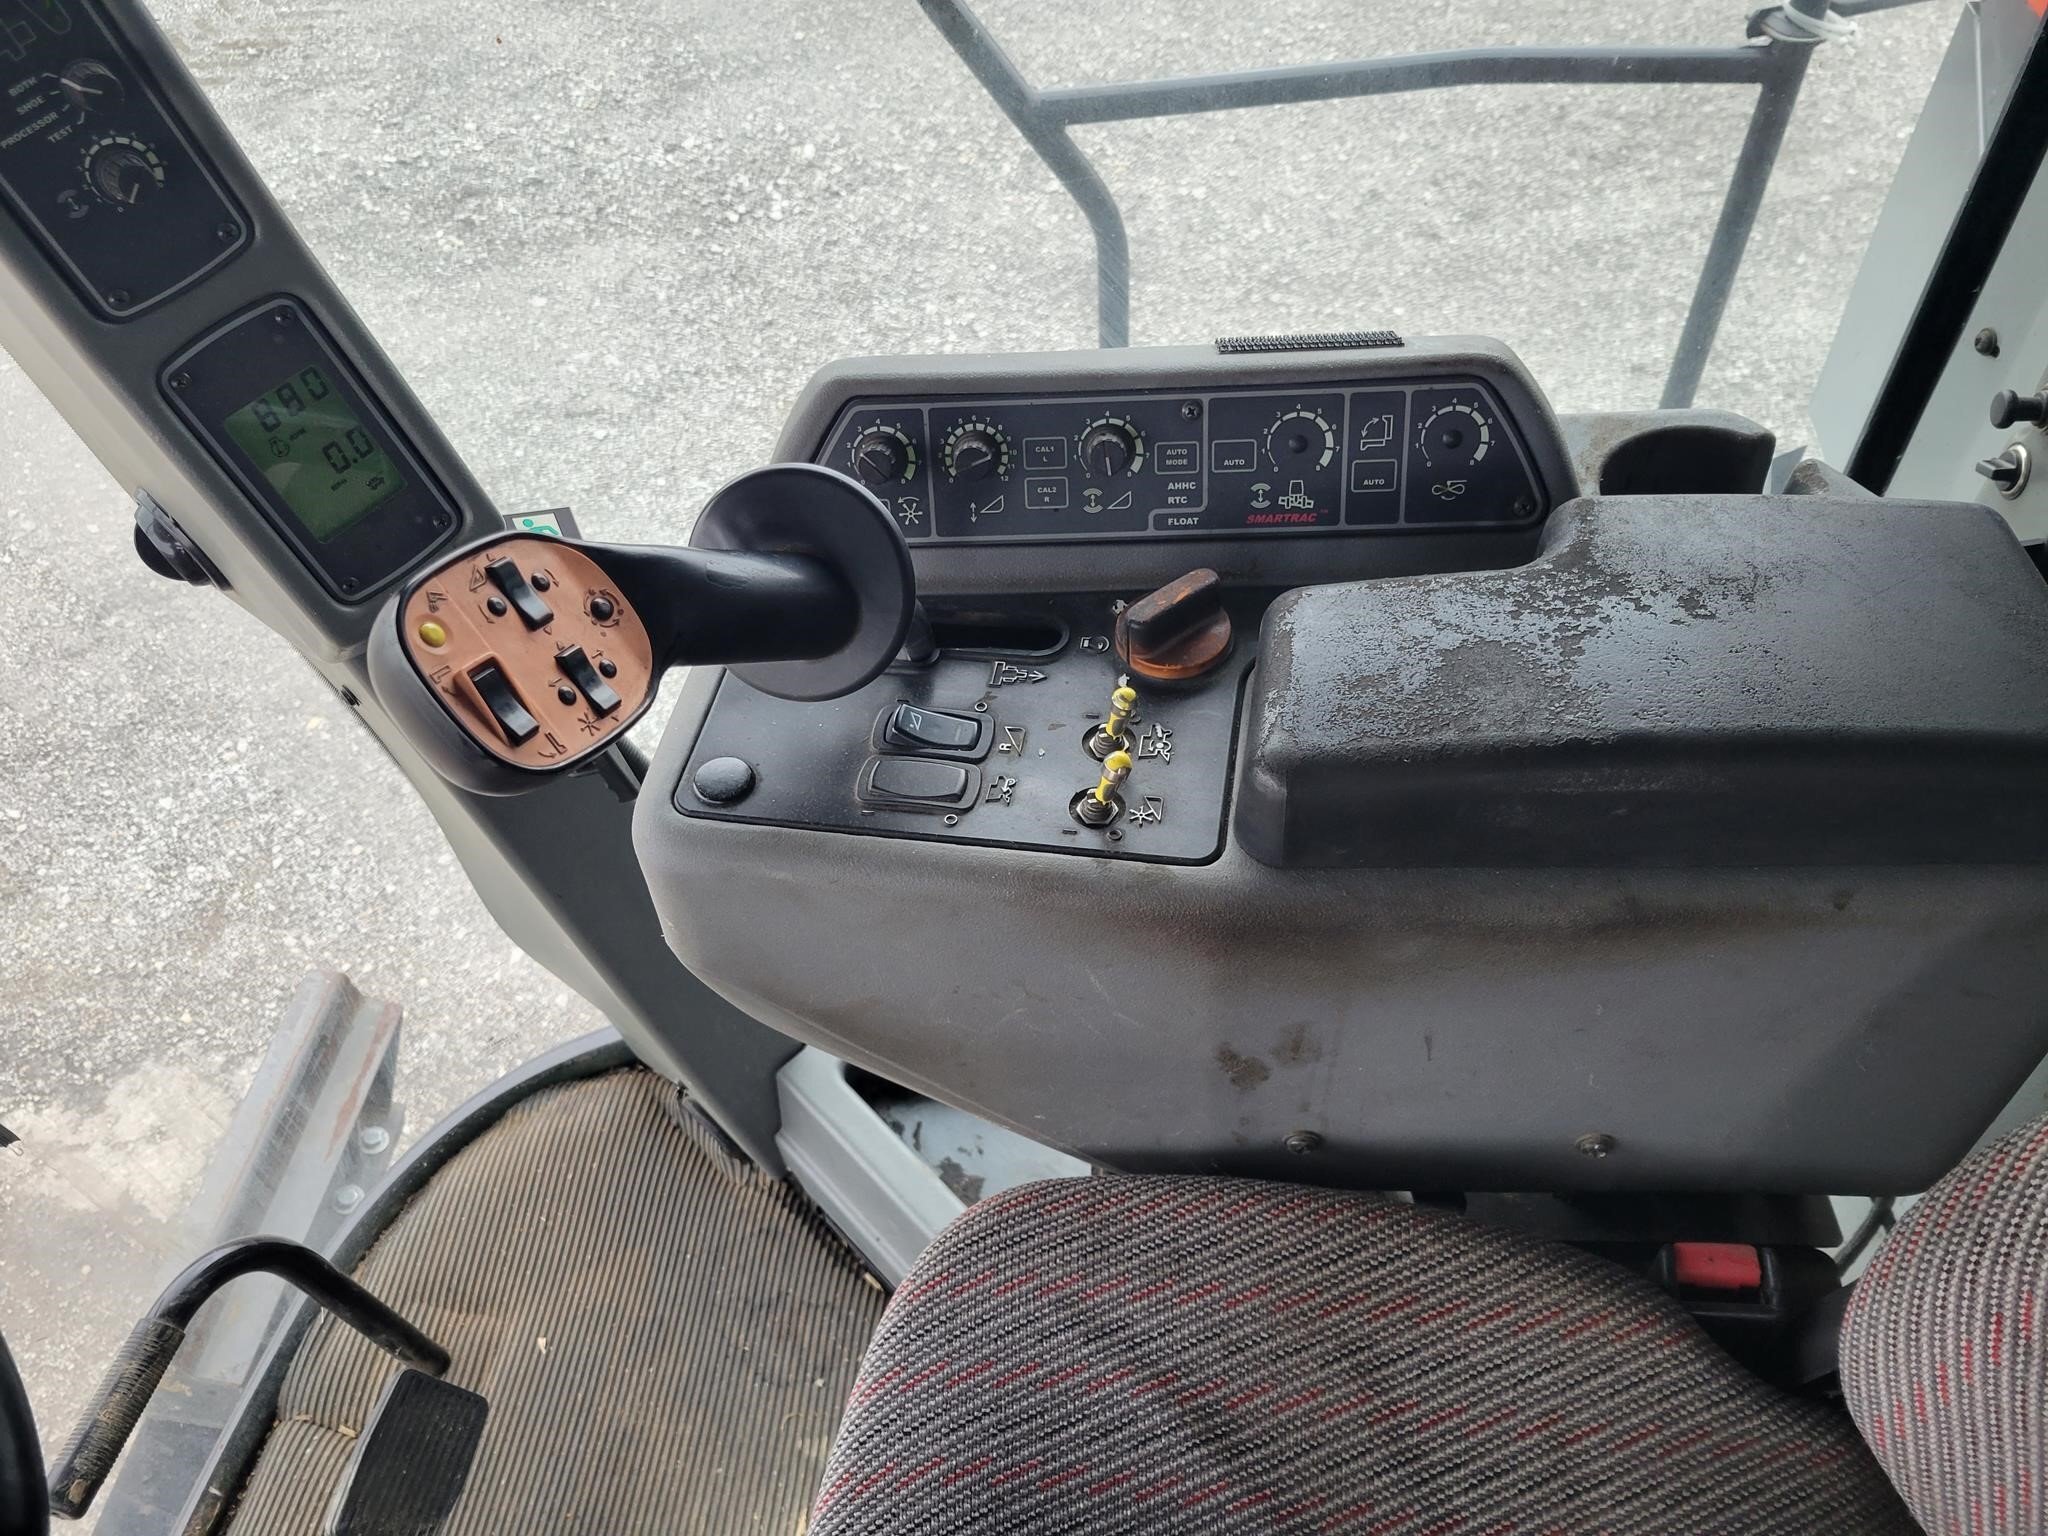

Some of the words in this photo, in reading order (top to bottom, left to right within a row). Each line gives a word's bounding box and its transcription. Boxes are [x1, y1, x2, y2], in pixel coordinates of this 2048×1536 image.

[16, 95, 47, 115] SHOE
[0, 111, 59, 149] PROCESSOR
[47, 125, 73, 144] TEST
[322, 427, 375, 474] 0.0
[1009, 448, 1018, 456] 10
[1166, 448, 1188, 456] AUTO
[1007, 462, 1016, 470] 11
[1165, 458, 1188, 466] MODE
[1223, 459, 1245, 467] AUTO
[1167, 481, 1197, 490] AHHC
[1167, 496, 1188, 505] RTC
[1167, 517, 1200, 526] FLOAT
[1246, 512, 1318, 525] SMARTRAC
